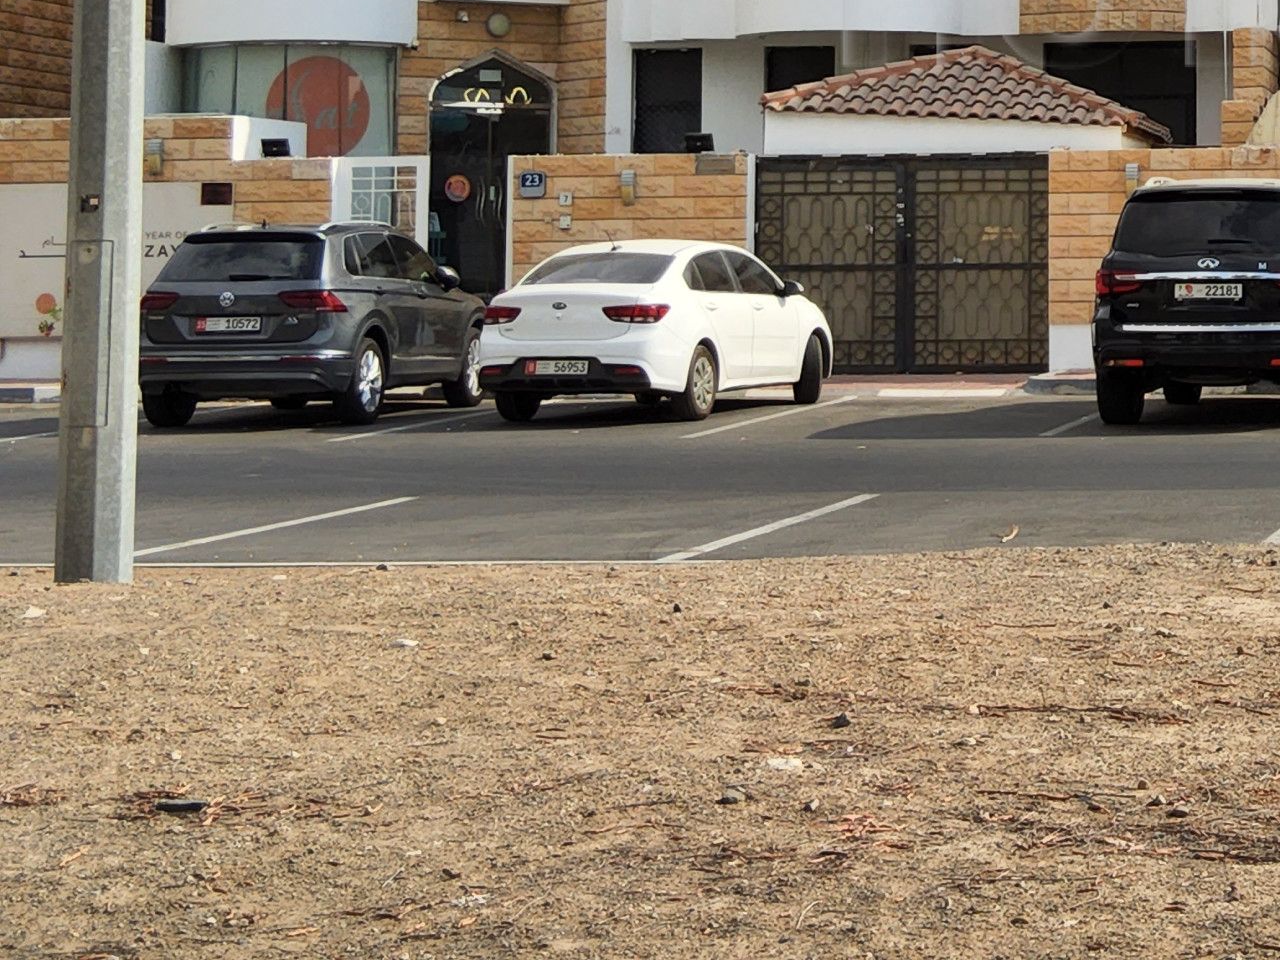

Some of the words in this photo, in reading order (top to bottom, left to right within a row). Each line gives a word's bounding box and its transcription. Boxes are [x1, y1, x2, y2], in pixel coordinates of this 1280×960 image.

[525, 174, 540, 186] 23
[144, 231, 172, 240] YEAR
[1205, 285, 1240, 297] 22181
[225, 318, 259, 329] 10572
[554, 362, 586, 373] 56953
